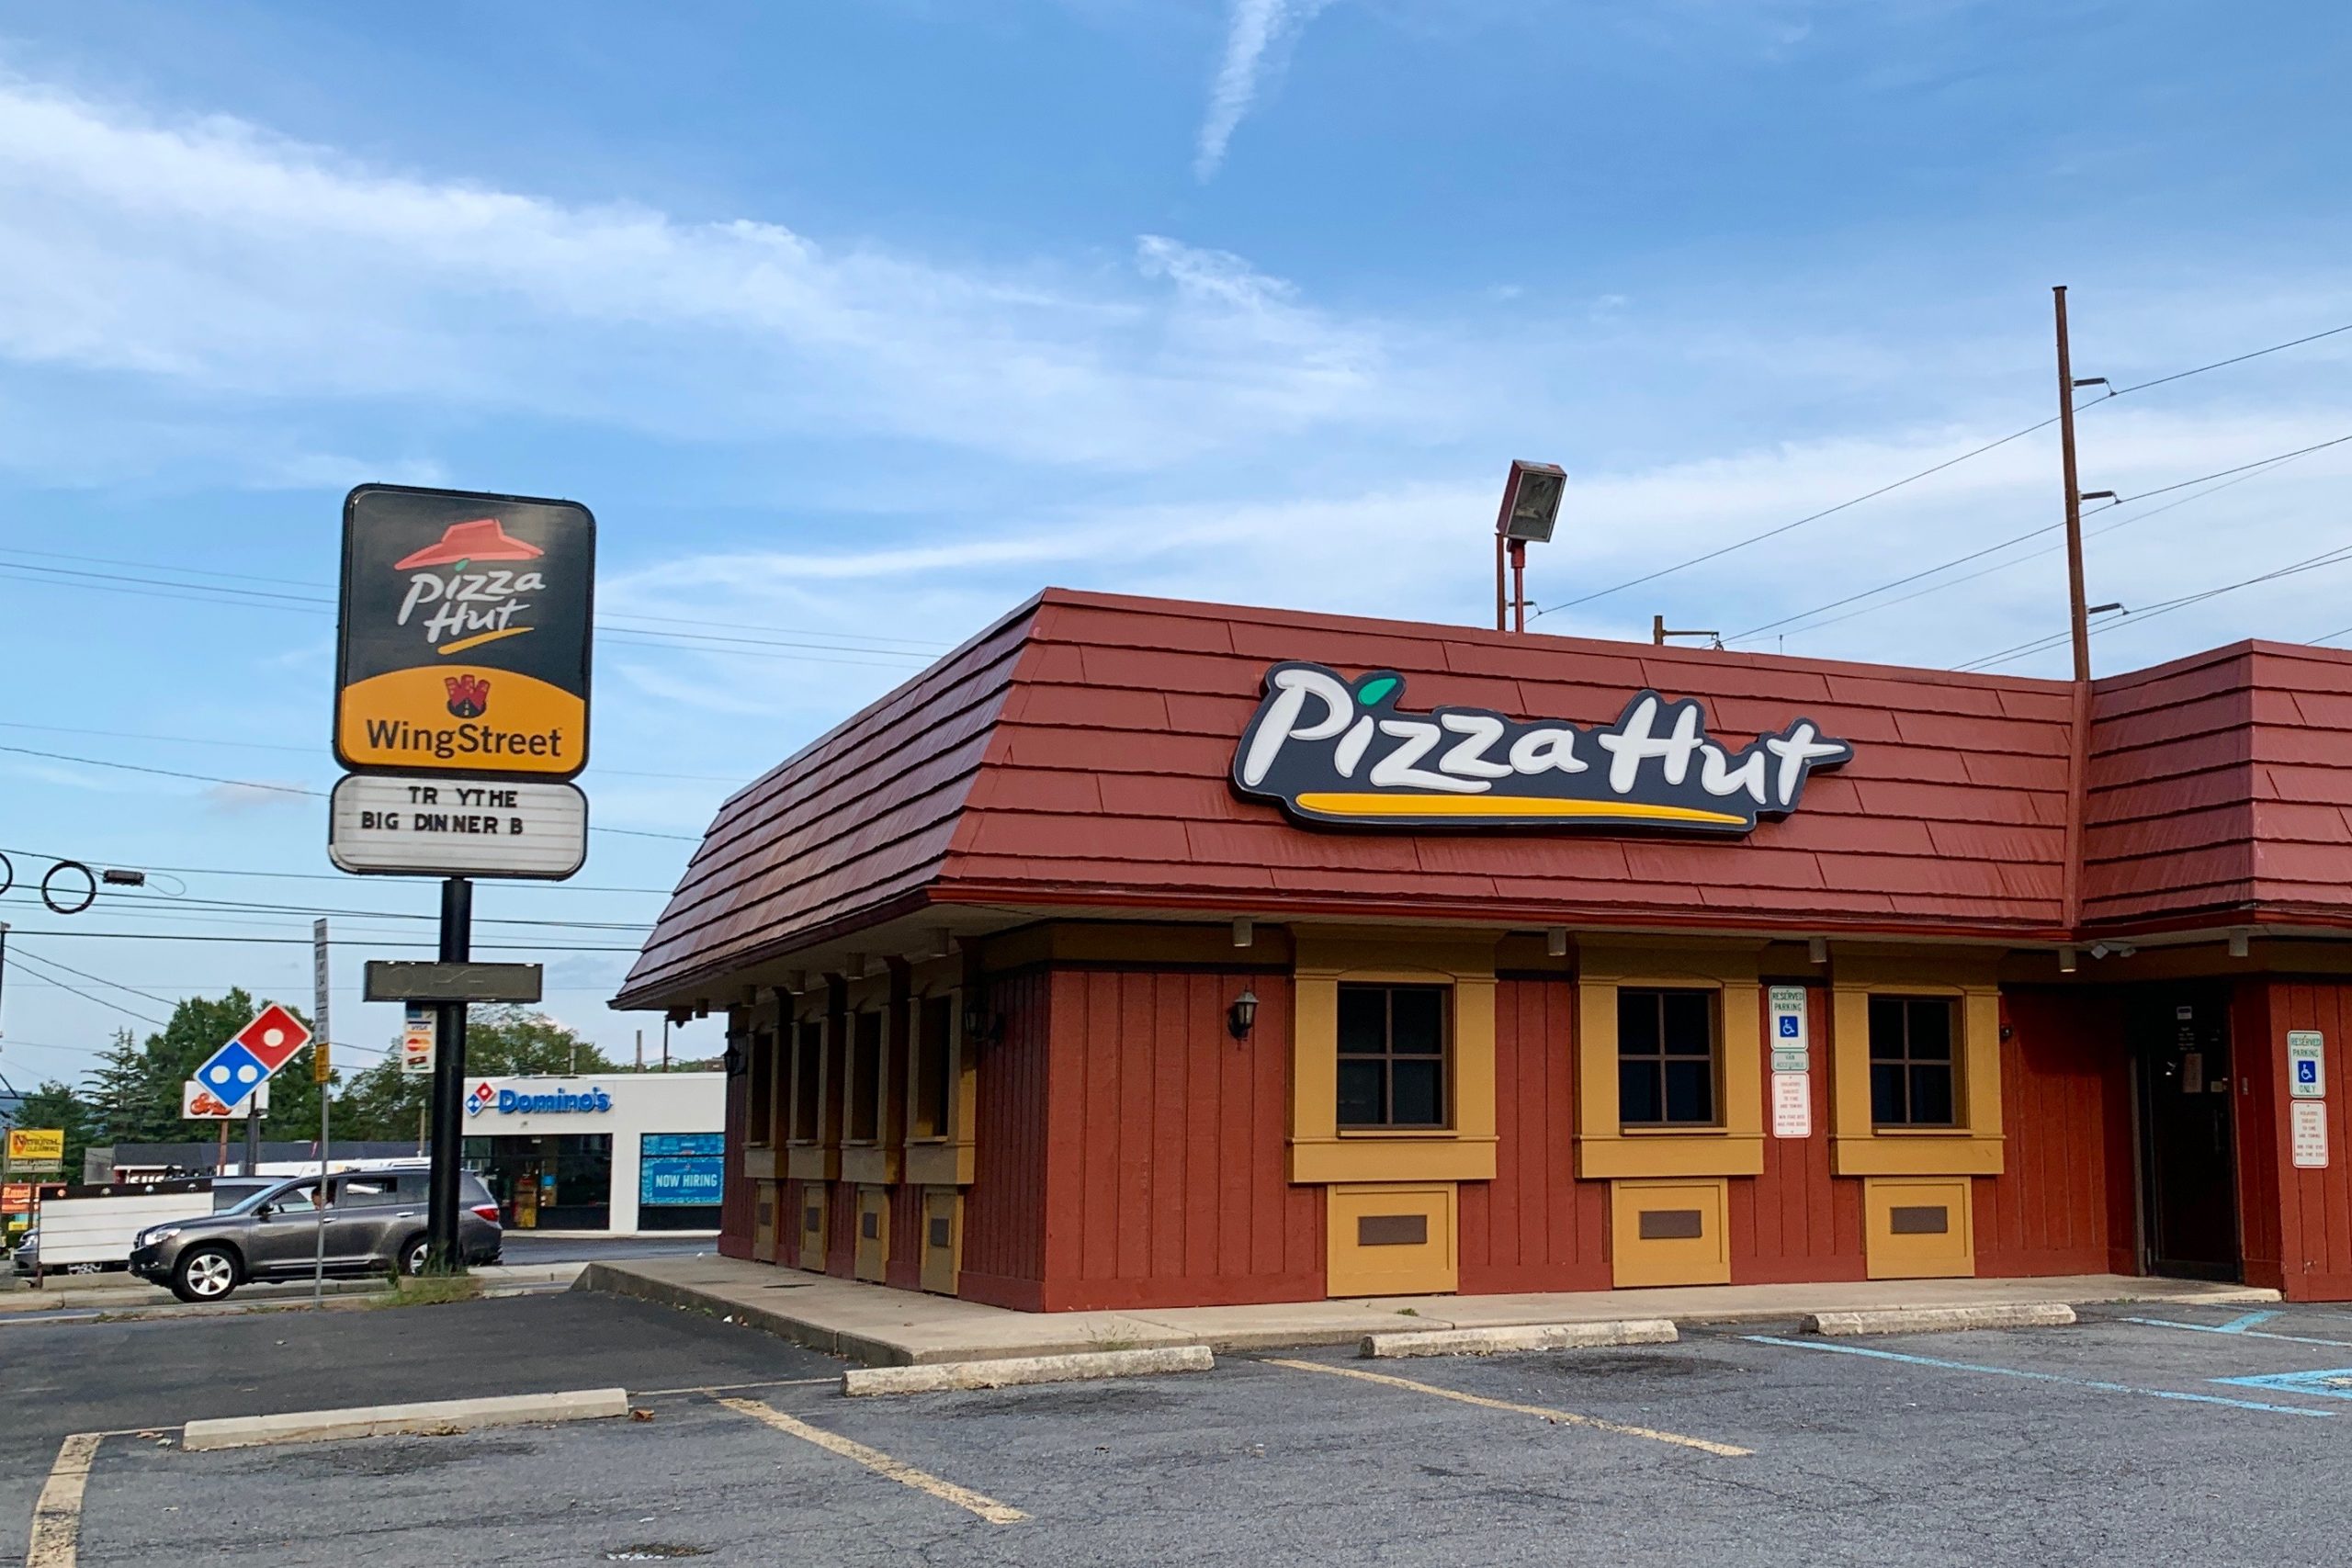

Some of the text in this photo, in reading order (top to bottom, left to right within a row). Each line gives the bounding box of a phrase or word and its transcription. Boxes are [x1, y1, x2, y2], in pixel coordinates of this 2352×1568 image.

[398, 559, 547, 626] Pizza
[423, 598, 531, 643] Hut
[367, 718, 563, 760] WingStreet
[1243, 669, 1846, 807] Pizza Hut
[408, 785, 518, 808] TR YTHE
[361, 810, 524, 835] BIG DINNER B
[1772, 992, 1804, 1001] RESERVED
[1774, 1002, 1803, 1011] PARKING
[2290, 1037, 2322, 1046] RESERVED
[2292, 1049, 2319, 1057] PARKING
[499, 1086, 613, 1114] Domino's
[2299, 1085, 2315, 1093] ONLY
[655, 1173, 718, 1188] NOW HIRING
